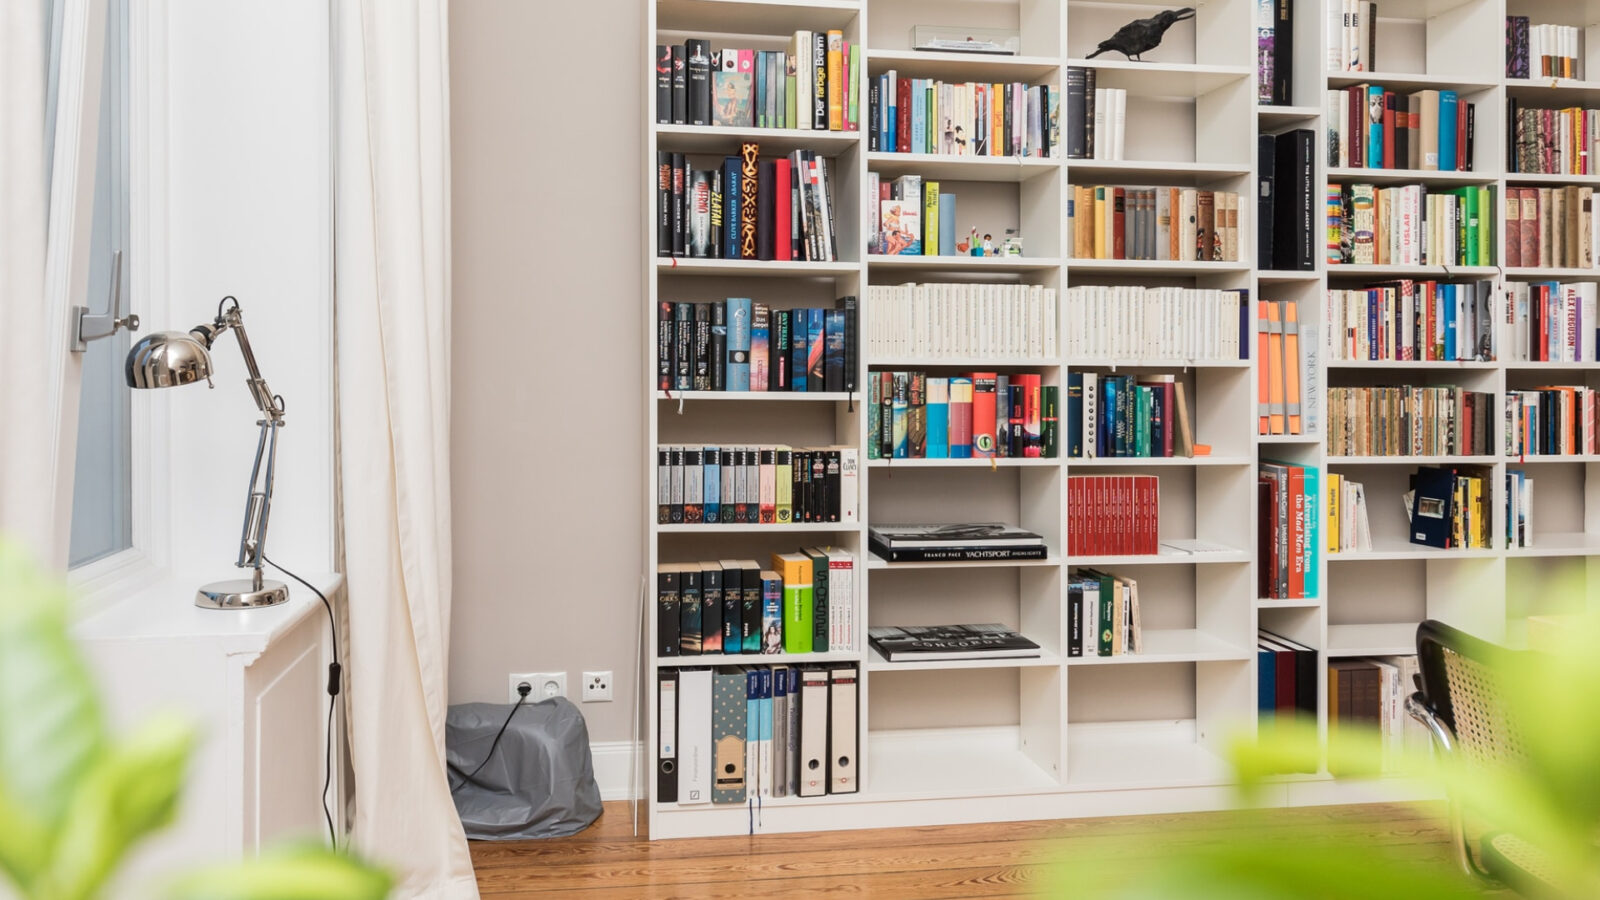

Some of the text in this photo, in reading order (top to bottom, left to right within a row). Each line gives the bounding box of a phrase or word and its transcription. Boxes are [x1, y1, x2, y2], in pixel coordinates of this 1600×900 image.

[815, 36, 825, 116] Der farbige Brehm
[711, 191, 722, 226] ZLATAN
[1568, 289, 1576, 346] ALEX FERGUSON
[1307, 352, 1317, 409] NEW YORK
[966, 550, 1011, 558] YACHTSPORT
[1295, 494, 1303, 573] the Mad Men Era
[1303, 494, 1312, 573] Advertising from
[912, 639, 1006, 648] CONCORDE
